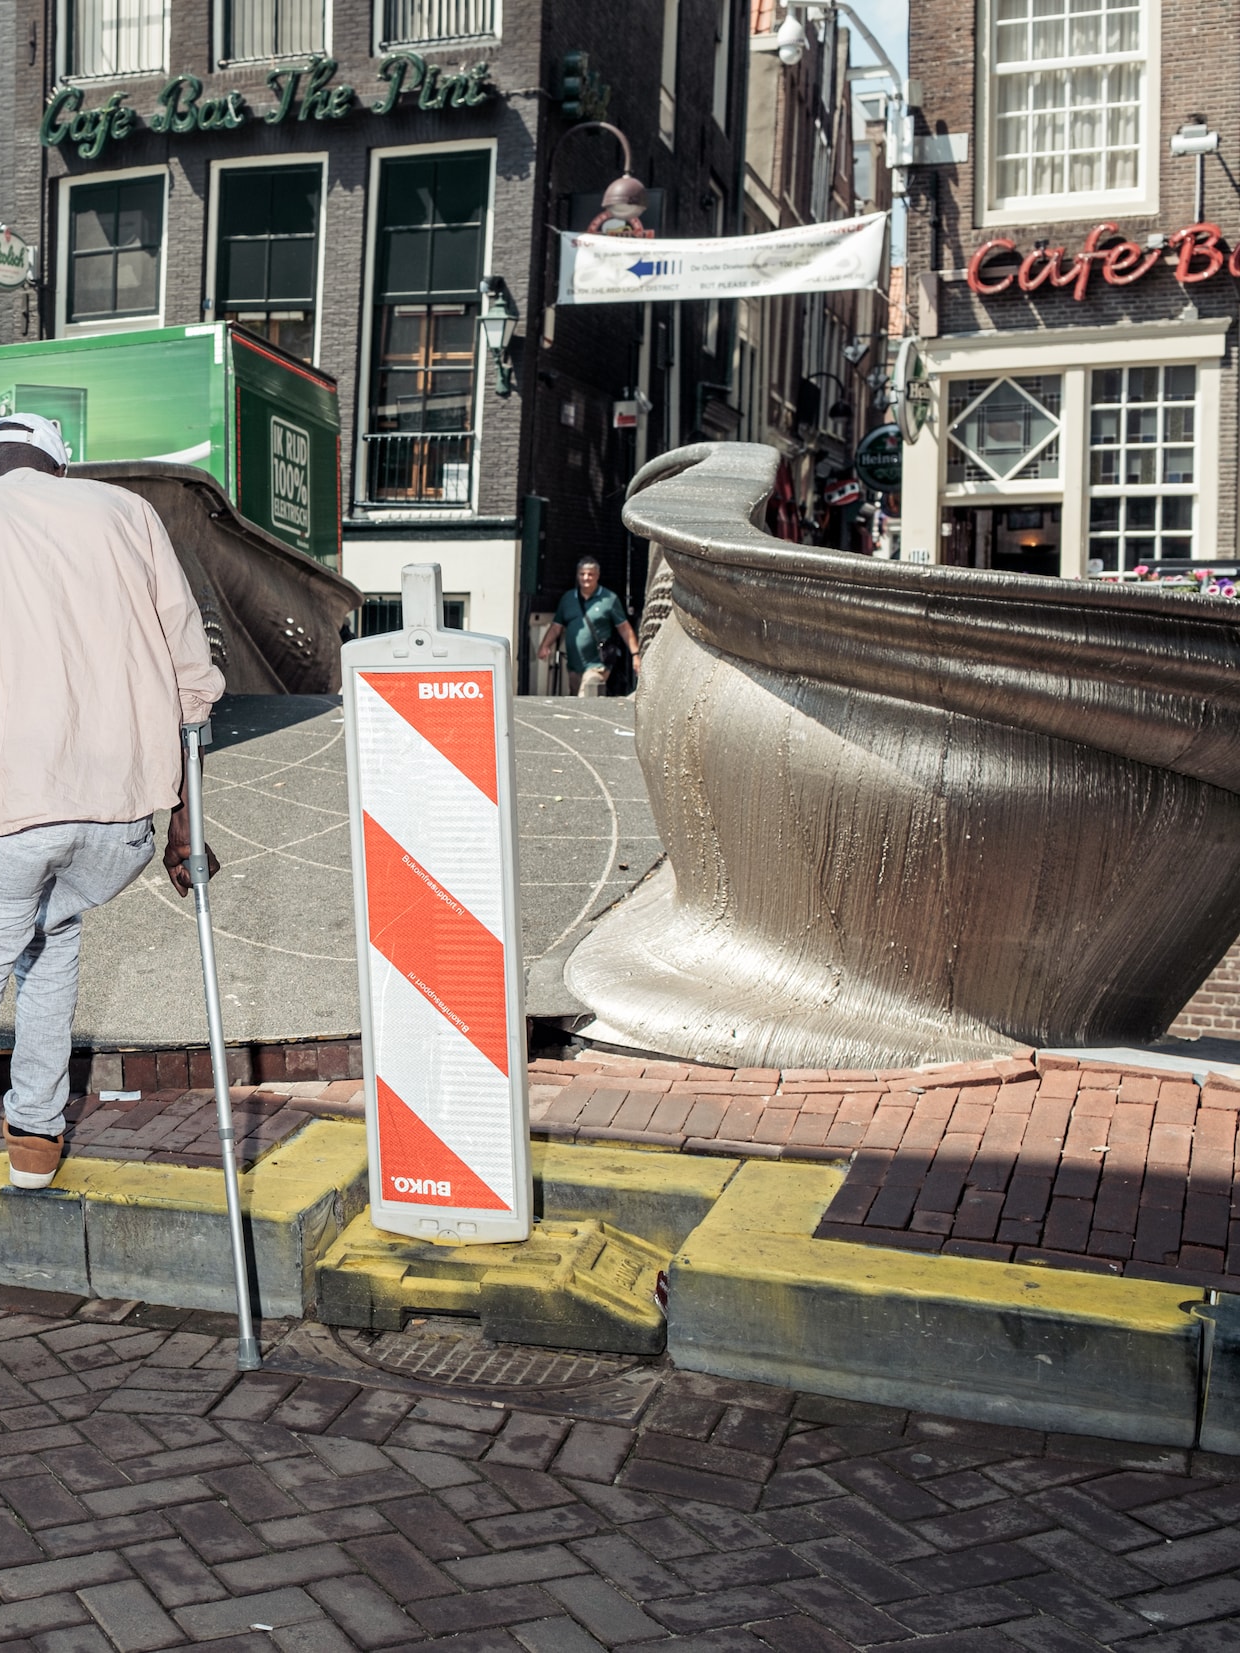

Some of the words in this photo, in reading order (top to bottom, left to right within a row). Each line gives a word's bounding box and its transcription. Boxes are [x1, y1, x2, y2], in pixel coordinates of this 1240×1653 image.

[150, 74, 247, 134] Bar
[265, 54, 356, 125] The
[371, 51, 492, 115] Pint
[967, 221, 1161, 301] Cafe
[1169, 222, 1240, 283] B
[273, 424, 285, 458] IK
[285, 433, 307, 467] RIJD
[273, 457, 308, 506] 100%
[273, 497, 308, 528] ELEKTRISCH
[418, 681, 484, 699] BUKO.
[401, 854, 465, 916] Bukoinfrasupport.nl
[407, 971, 470, 1033] Bukoinfrasupport.nl
[390, 1176, 451, 1197] BUKO.
